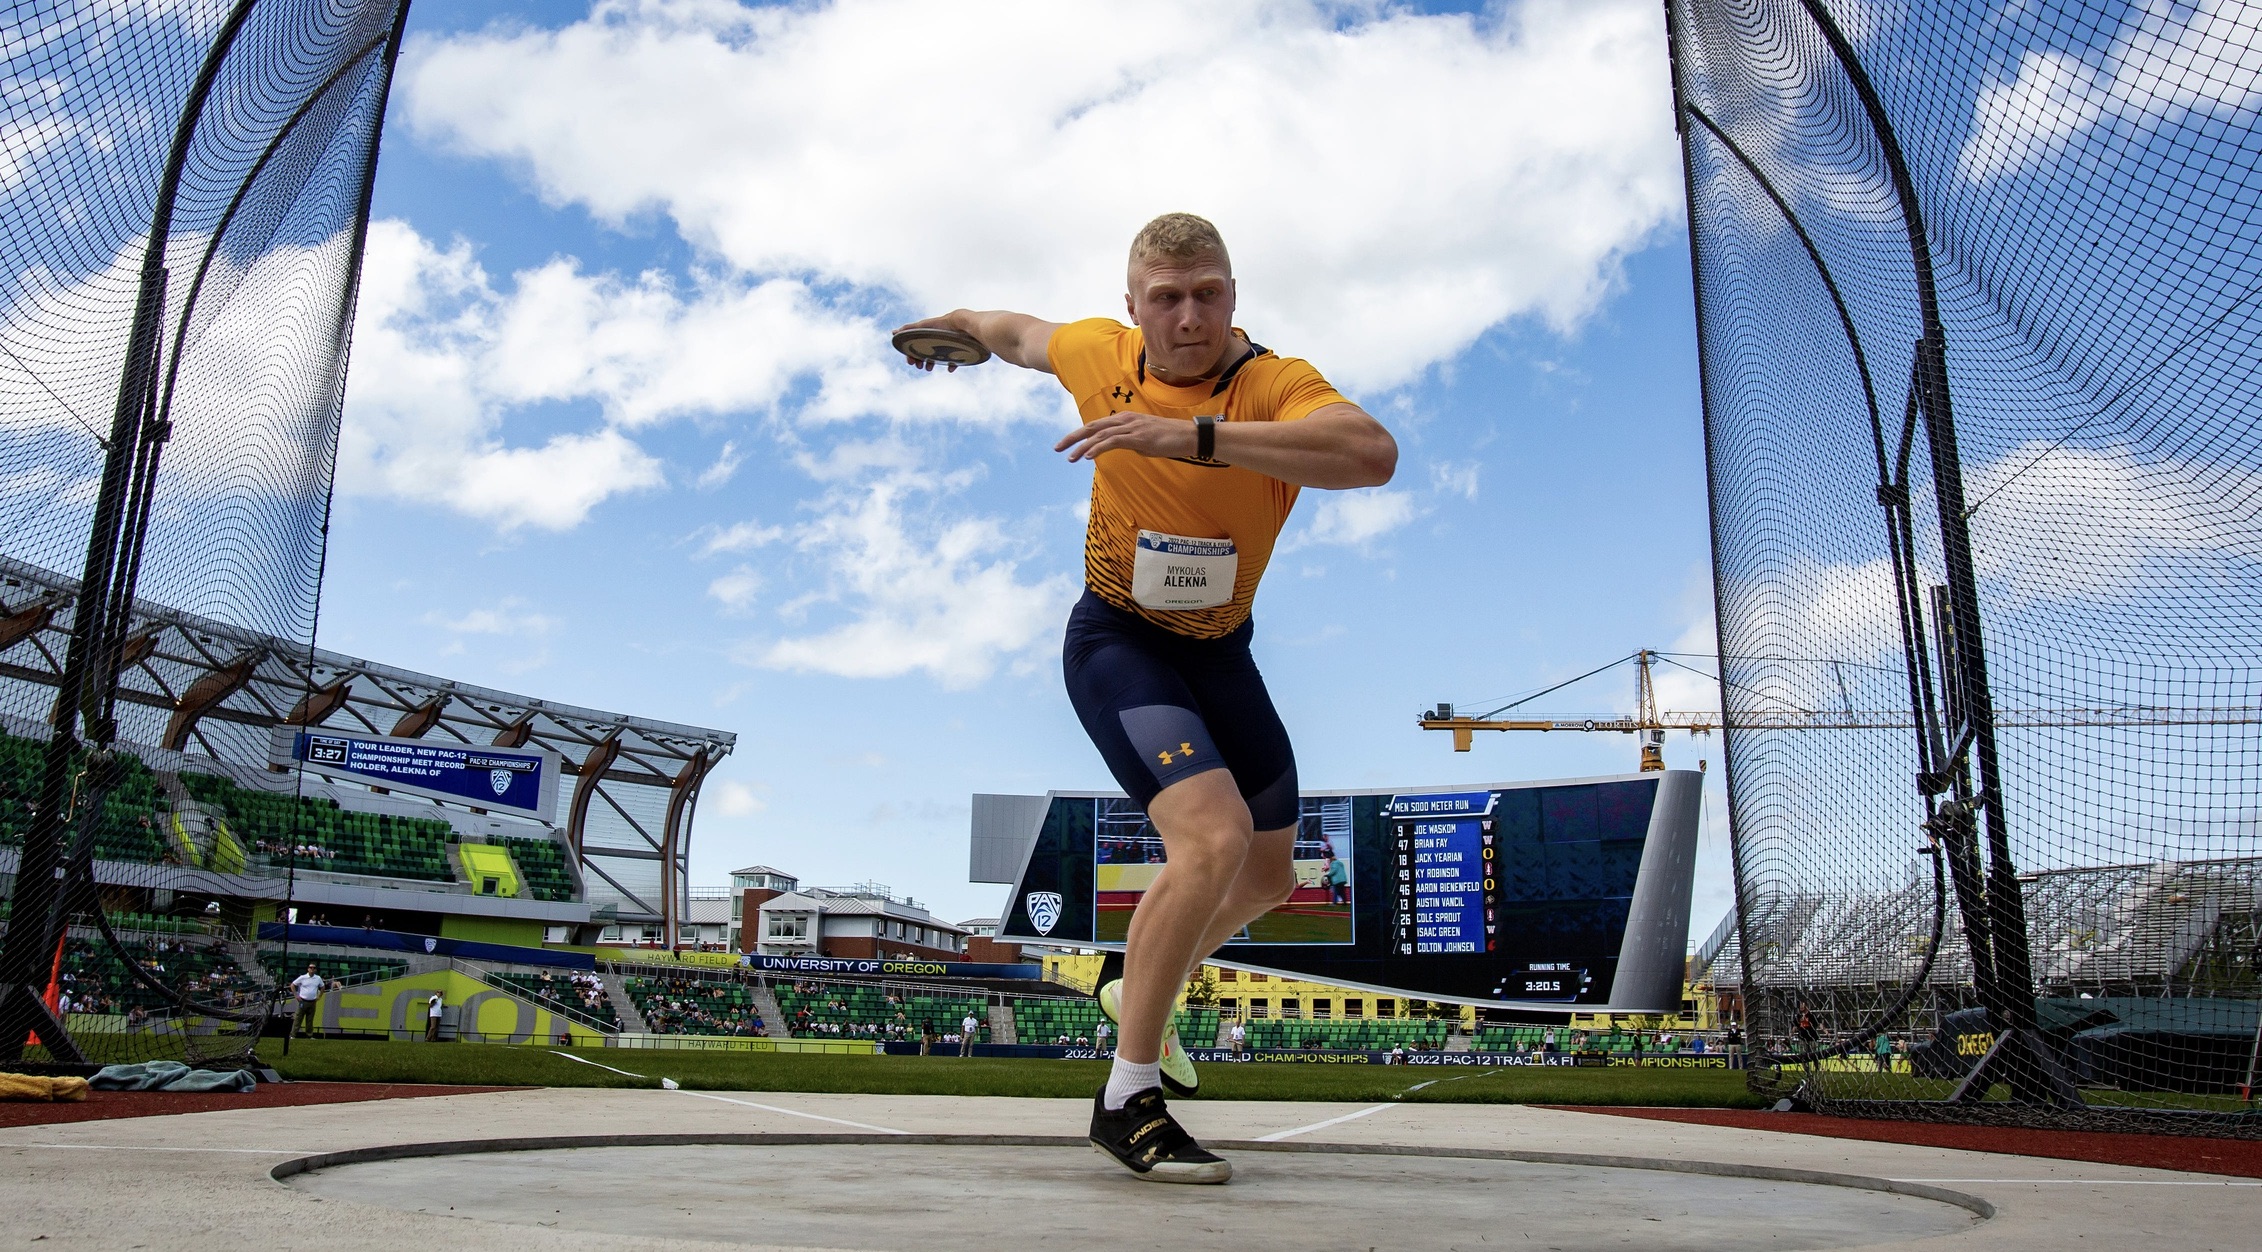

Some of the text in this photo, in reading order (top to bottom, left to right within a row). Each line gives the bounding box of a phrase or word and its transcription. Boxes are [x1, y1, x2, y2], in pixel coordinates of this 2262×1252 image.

[1167, 543, 1230, 556] CHAMPIONSHIPS
[1167, 566, 1206, 576] MYKOLAS
[1164, 576, 1207, 588] ALEKNA
[314, 748, 342, 760] 3:27
[353, 742, 467, 760] YOUR LEADER, NEW PAC-12
[351, 752, 466, 770] CHAMPIONSHIP MEET RECORD
[469, 758, 531, 770] PAC-12 CHAMPIONSHIPS
[350, 762, 442, 777] HOLDER, ALEKNA OF
[1394, 800, 1469, 813] MEN 5000 METER RUN
[1398, 826, 1404, 837] 9
[1414, 824, 1428, 835] JOE
[1429, 824, 1456, 834] WASKOM
[1398, 840, 1408, 851] 47
[1414, 838, 1434, 849] BRIAN
[1436, 838, 1448, 848] FAY
[1399, 854, 1408, 866] 18
[1415, 853, 1432, 864] JACK
[1434, 852, 1462, 862] YEARIAN
[1398, 868, 1460, 881] 49 KY ROBINSON
[1400, 884, 1410, 896] 46
[1416, 883, 1438, 893] AARON
[1440, 882, 1480, 892] BIENENFELD
[1400, 896, 1465, 910] 13 AUSTIN VANCIL
[1037, 914, 1051, 928] 12
[1400, 912, 1461, 926] 26 COLE SPROUT
[1400, 928, 1406, 939] 4
[1417, 927, 1437, 938] ISAAC
[1438, 926, 1461, 937] GREEN
[1401, 941, 1475, 954] 48 COLTON JOHNSEN
[700, 956, 728, 965] FIELD
[762, 958, 854, 972] UNIVERSITY
[858, 962, 880, 972] OF
[882, 962, 947, 974] OREGON
[1529, 962, 1570, 971] RUNNING TIME
[1525, 981, 1560, 991] 3:20.5
[740, 1042, 768, 1050] FIELD
[1957, 1032, 1996, 1056] OREGO
[1064, 1048, 1096, 1059] 2022
[1198, 1052, 1210, 1062] &
[1213, 1052, 1252, 1062] FIED
[1254, 1052, 1369, 1064] CHAMPIONSHIPS
[1408, 1054, 1440, 1065] 2022
[1444, 1055, 1491, 1066] PAC-12
[1494, 1056, 1531, 1066] TRAC
[1546, 1056, 1558, 1066] &
[1129, 1117, 1168, 1145] UNDER
